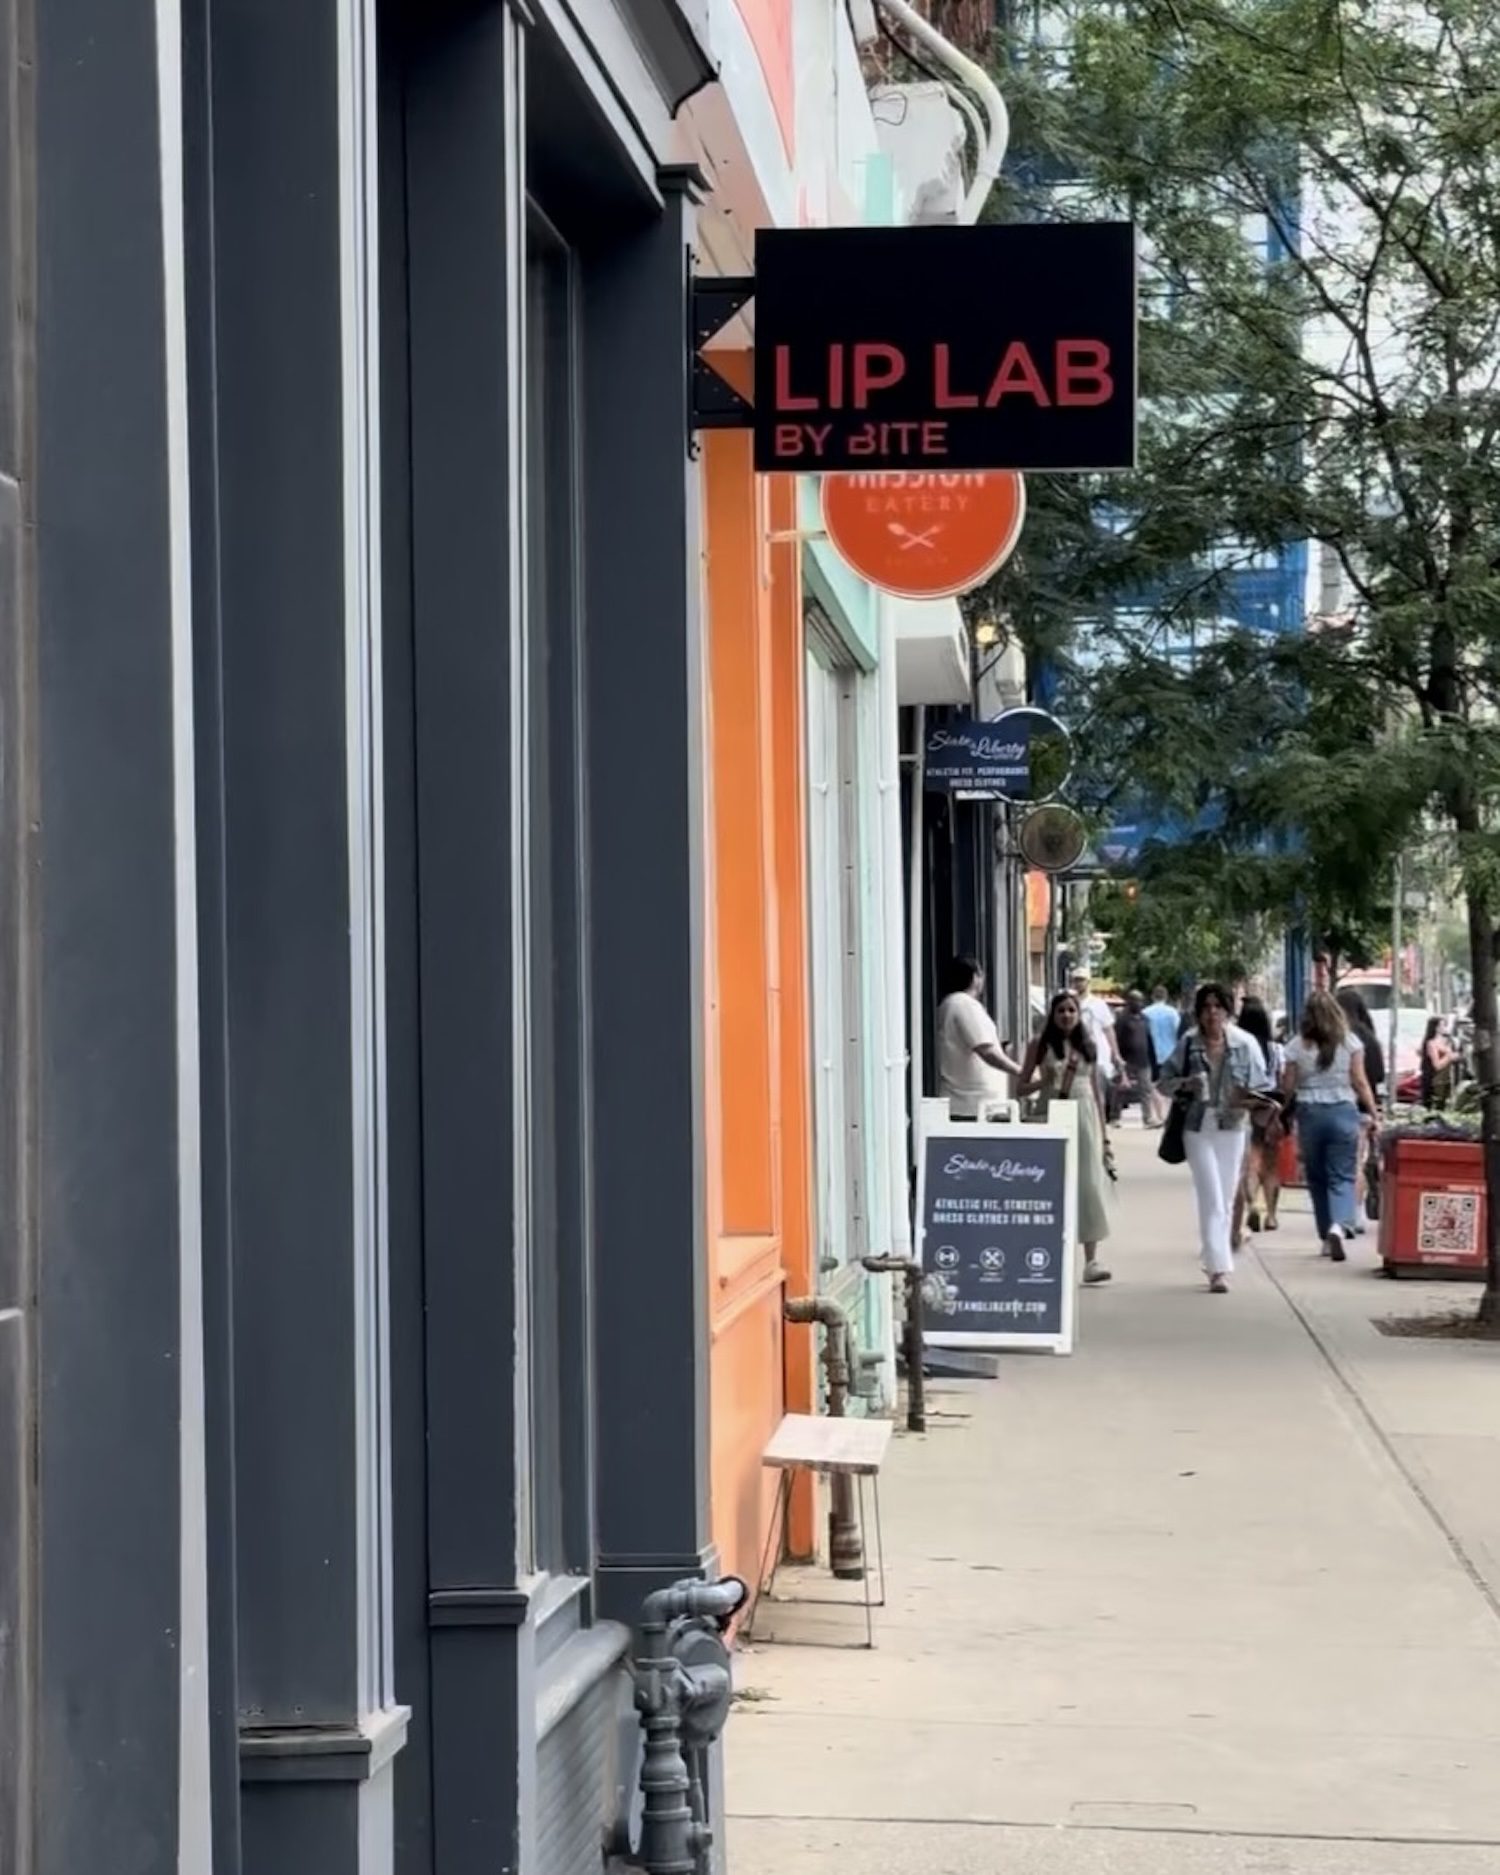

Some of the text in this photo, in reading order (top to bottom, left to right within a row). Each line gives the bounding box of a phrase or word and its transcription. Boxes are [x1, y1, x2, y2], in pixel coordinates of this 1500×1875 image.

[775, 339, 1114, 411] LIP LAB
[775, 421, 949, 456] BY BITE
[866, 496, 969, 512] EATERY
[935, 1198, 980, 1210] ATHLETIC
[1003, 1199, 1053, 1211] STRETCHY
[932, 1212, 1055, 1225] DRESS CLOTHES FOR MEN
